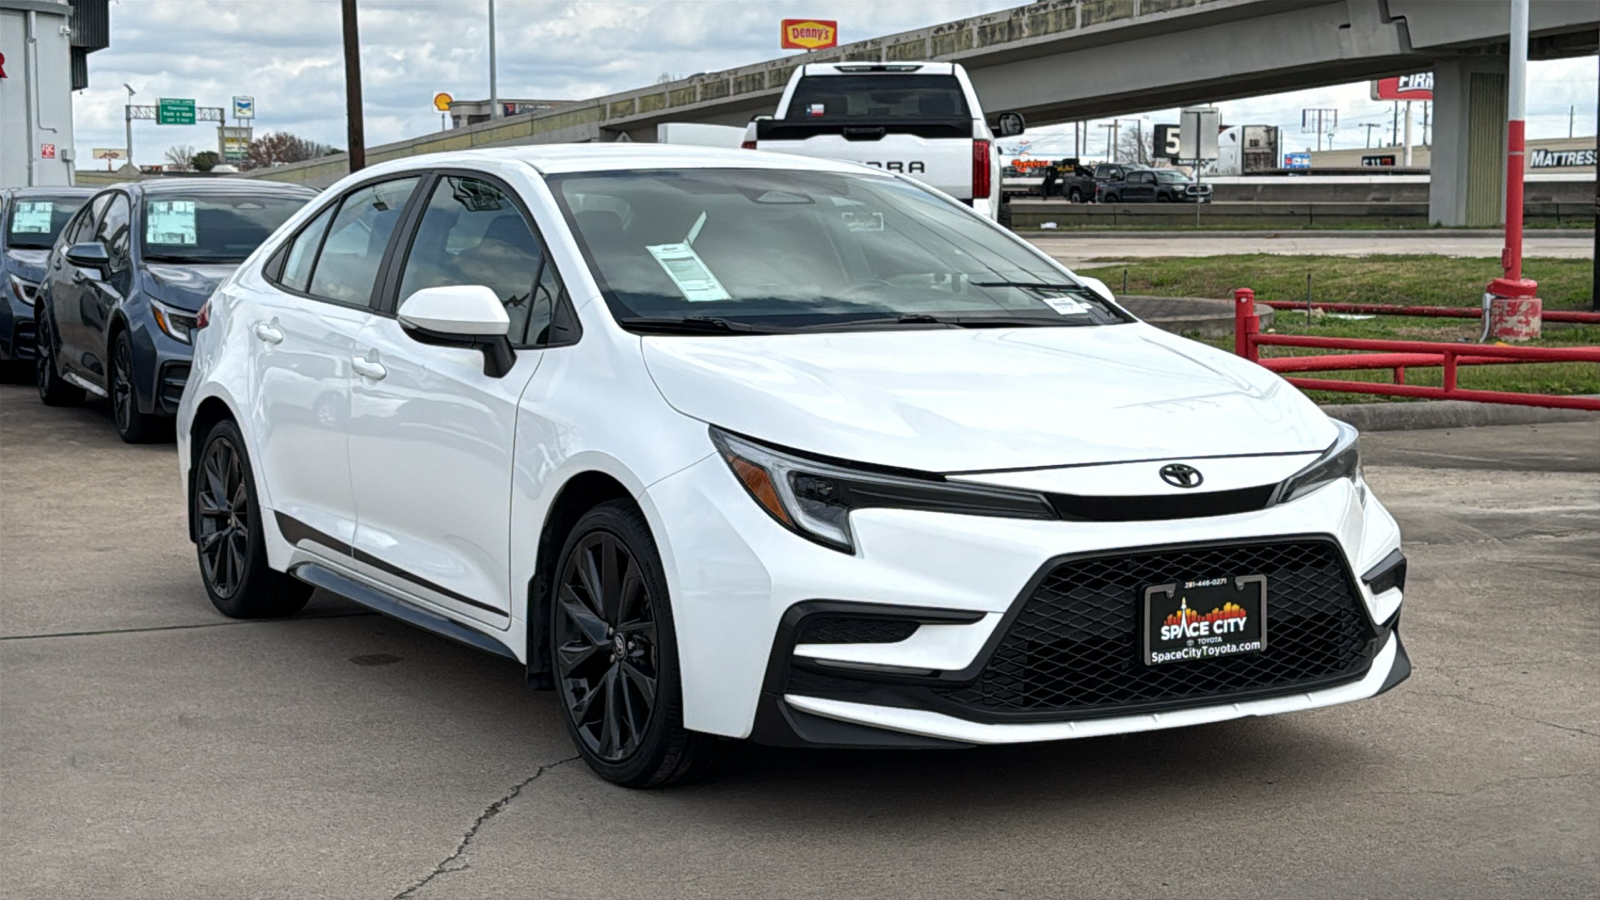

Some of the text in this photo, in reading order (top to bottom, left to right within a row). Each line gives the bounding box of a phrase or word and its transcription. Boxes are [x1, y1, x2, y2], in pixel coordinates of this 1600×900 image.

[792, 27, 830, 41] Denny's
[1161, 617, 1247, 640] SPACE CITY
[1198, 637, 1222, 645] TOYOTA
[1152, 641, 1261, 663] SpaceCityToyota.com
